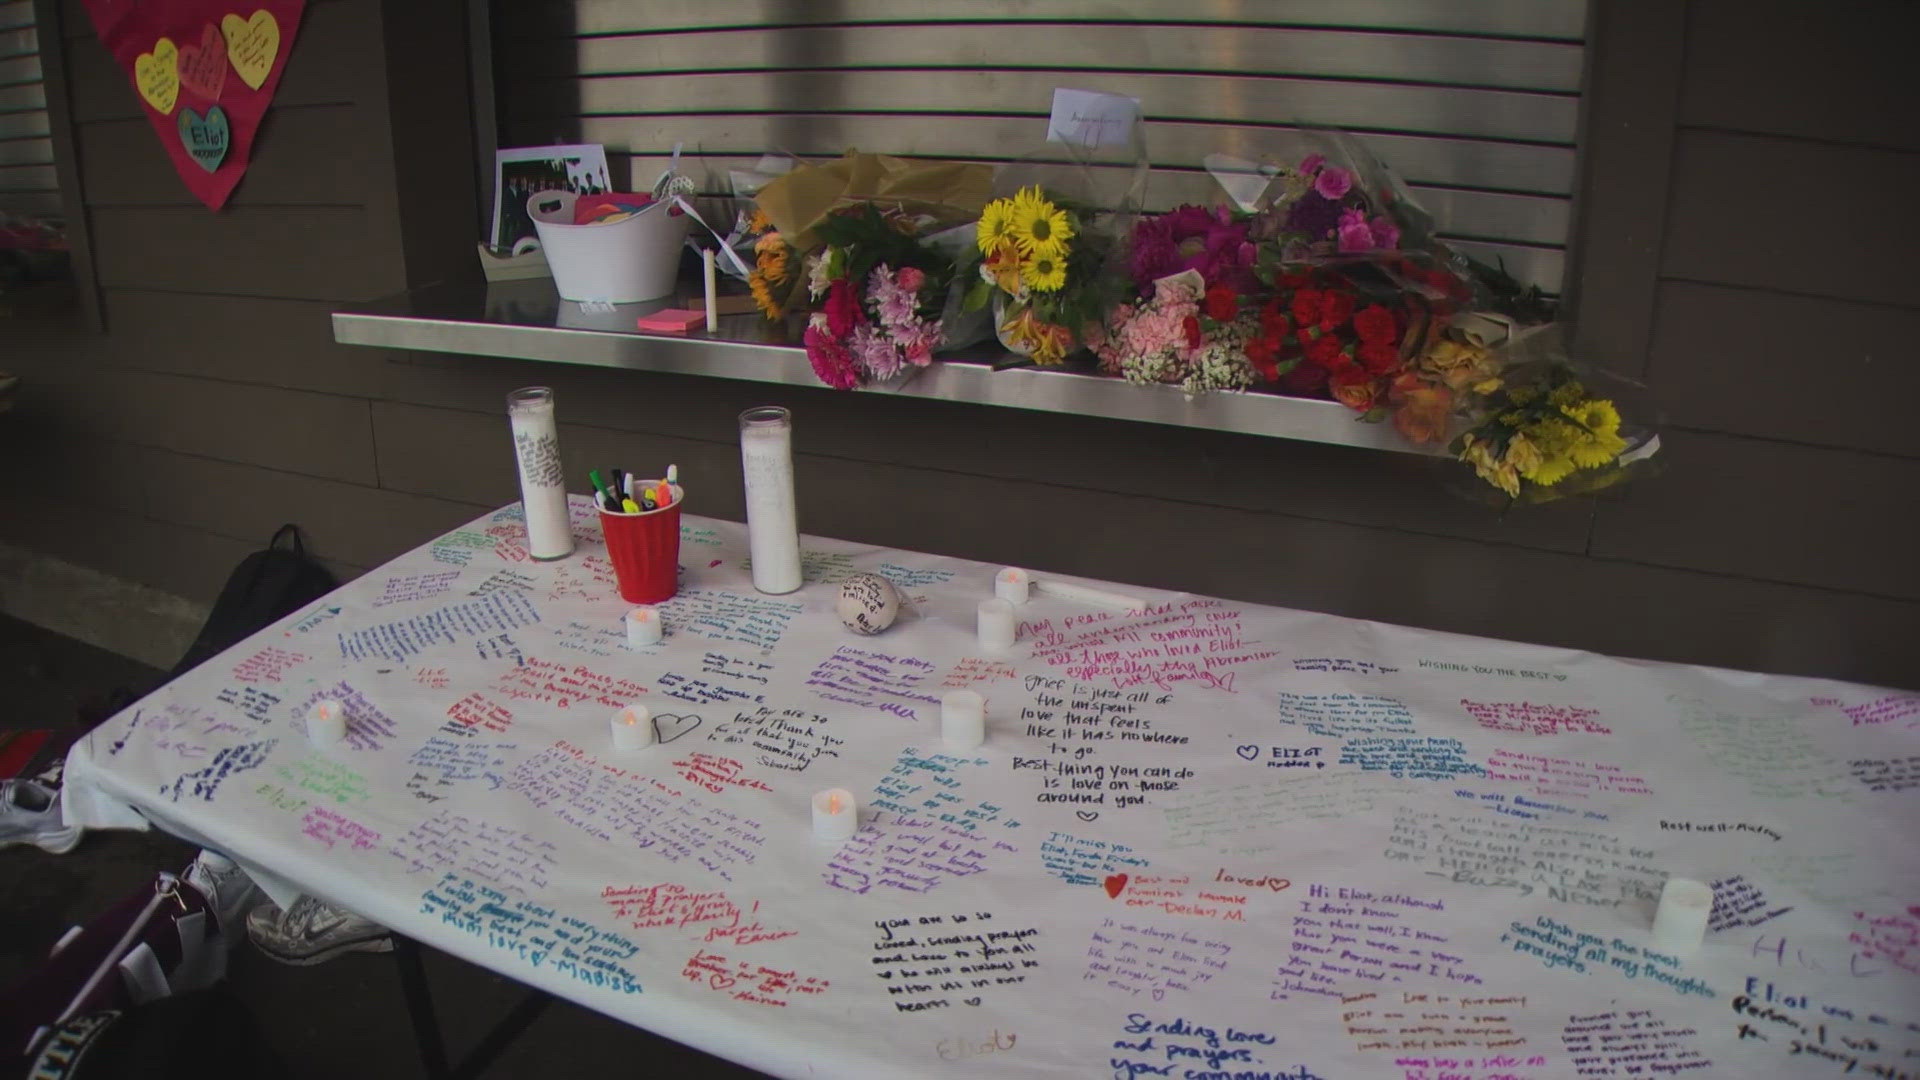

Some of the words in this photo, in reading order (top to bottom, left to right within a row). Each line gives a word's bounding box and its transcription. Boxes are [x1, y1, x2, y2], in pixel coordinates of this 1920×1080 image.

[190, 126, 225, 146] Eliot
[1418, 659, 1469, 673] WISHING
[1473, 666, 1492, 675] YOU
[1497, 668, 1516, 677] THE
[1521, 670, 1549, 680] BEST
[1035, 692, 1063, 706] the
[1071, 700, 1137, 714] unspent
[1073, 684, 1086, 694] is
[1127, 692, 1149, 702] all
[1156, 694, 1173, 705] of
[1021, 707, 1053, 720] love
[1065, 712, 1101, 725] that
[1110, 716, 1150, 729] feels
[1027, 724, 1055, 737] like
[1063, 728, 1076, 739] it
[1082, 729, 1114, 740] has
[1047, 743, 1066, 754] to
[1013, 757, 1052, 770] Best
[1056, 762, 1104, 780] thing
[1110, 765, 1138, 778] you
[1143, 768, 1170, 777] can
[1174, 767, 1194, 778] do
[1044, 776, 1059, 788] is
[1072, 778, 1101, 789] love
[1109, 781, 1129, 790] on
[1037, 794, 1104, 804] around
[1659, 819, 1691, 832] Rest
[1215, 868, 1268, 888] loved
[1310, 884, 1330, 898] Hi
[1576, 932, 1604, 947] you
[1611, 938, 1638, 955] the
[1510, 921, 1580, 960] Sending
[1585, 948, 1607, 963] all
[1611, 956, 1639, 979] my
[1642, 965, 1716, 998] thoughts
[1125, 1013, 1220, 1049] Sending
[1113, 1037, 1158, 1052] and
